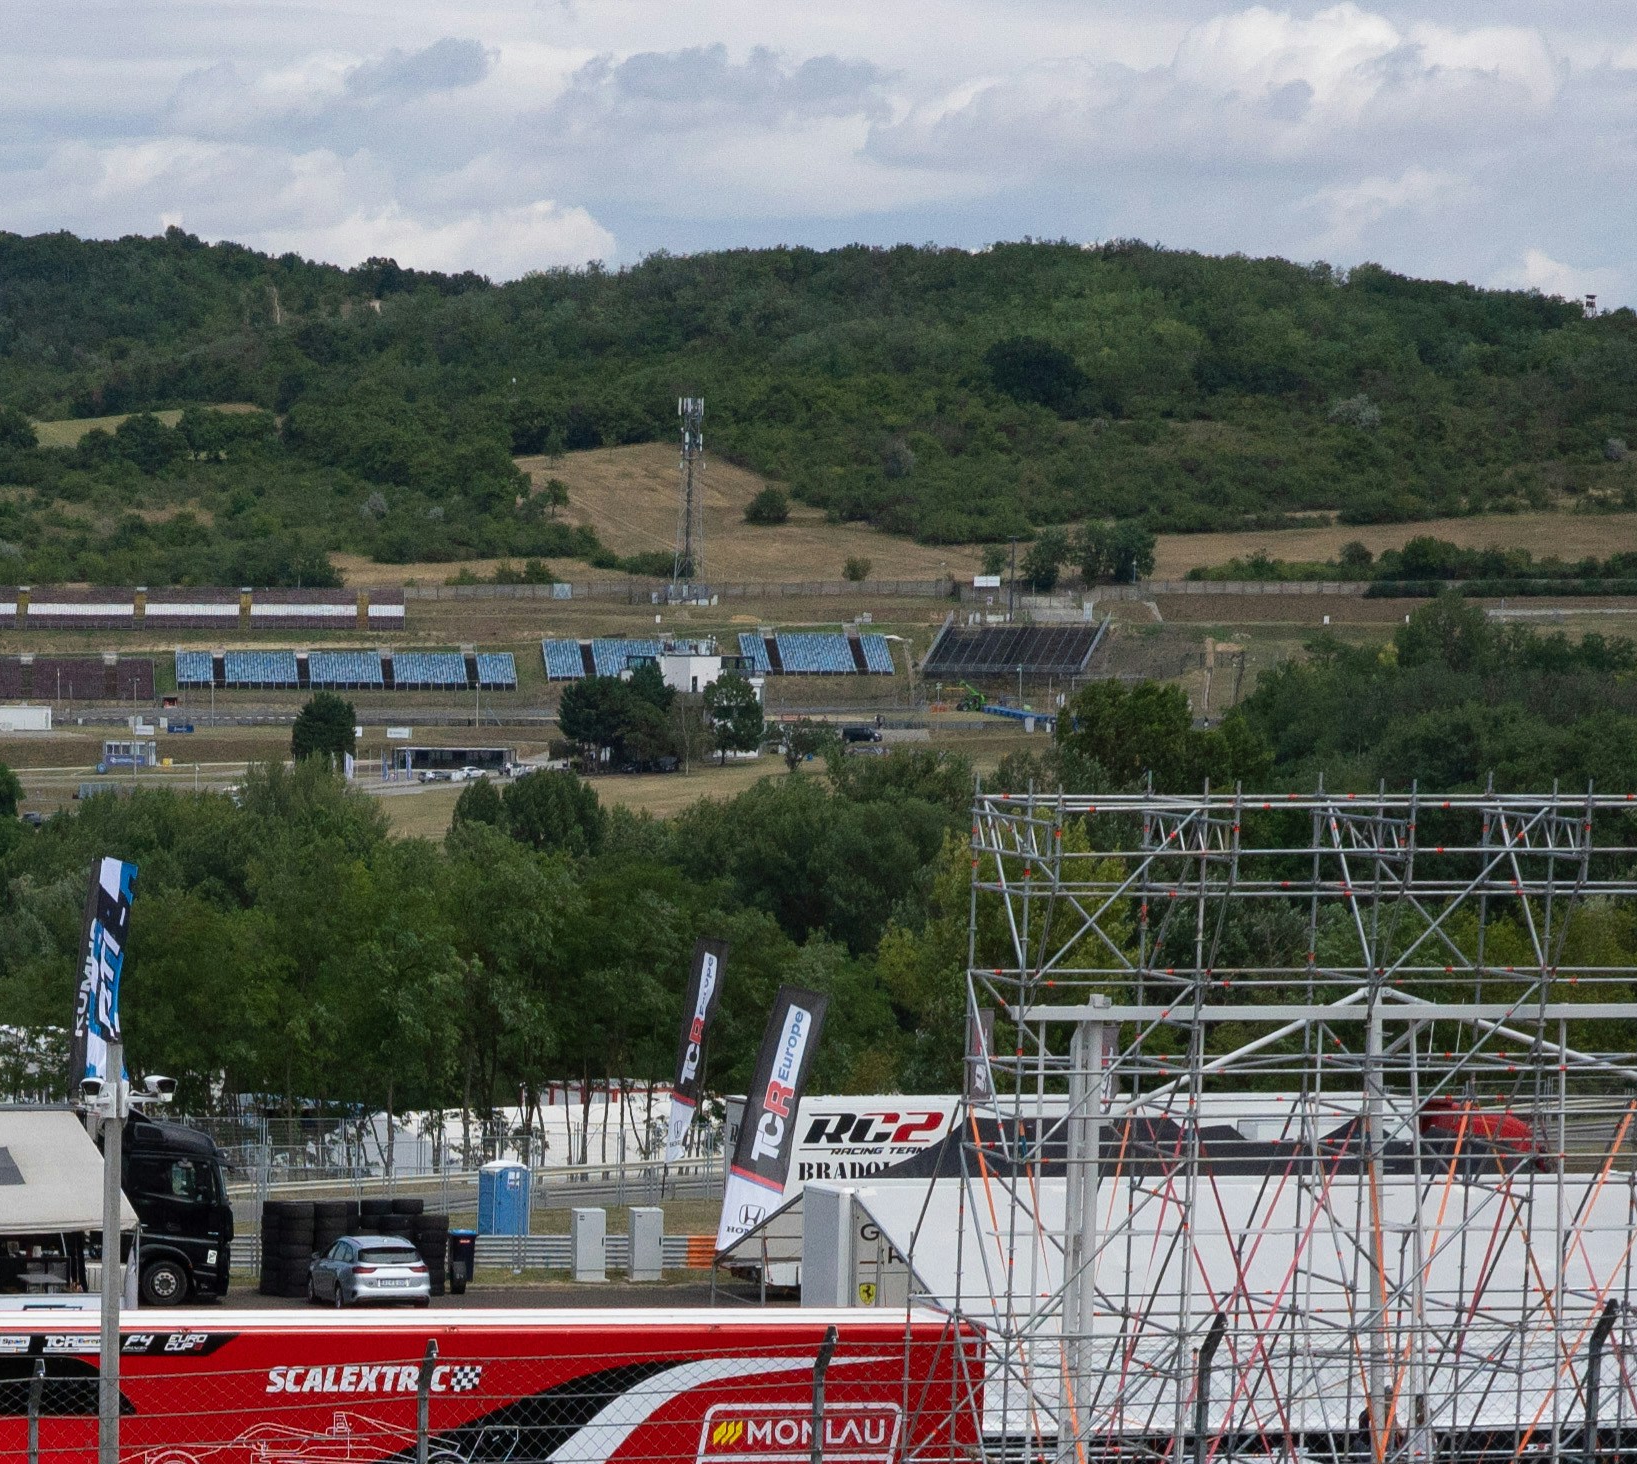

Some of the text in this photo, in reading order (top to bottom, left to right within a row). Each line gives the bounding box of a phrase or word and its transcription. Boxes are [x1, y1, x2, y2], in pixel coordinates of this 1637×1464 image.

[750, 1010, 804, 1162] TCR Europe
[803, 1112, 944, 1143] RC2
[830, 1147, 884, 1155] RACING
[45, 1335, 78, 1348] TCR
[125, 1334, 155, 1346] F4
[169, 1334, 209, 1343] EURO
[165, 1343, 194, 1351] CUP
[266, 1365, 450, 1393] SCALEXTRC
